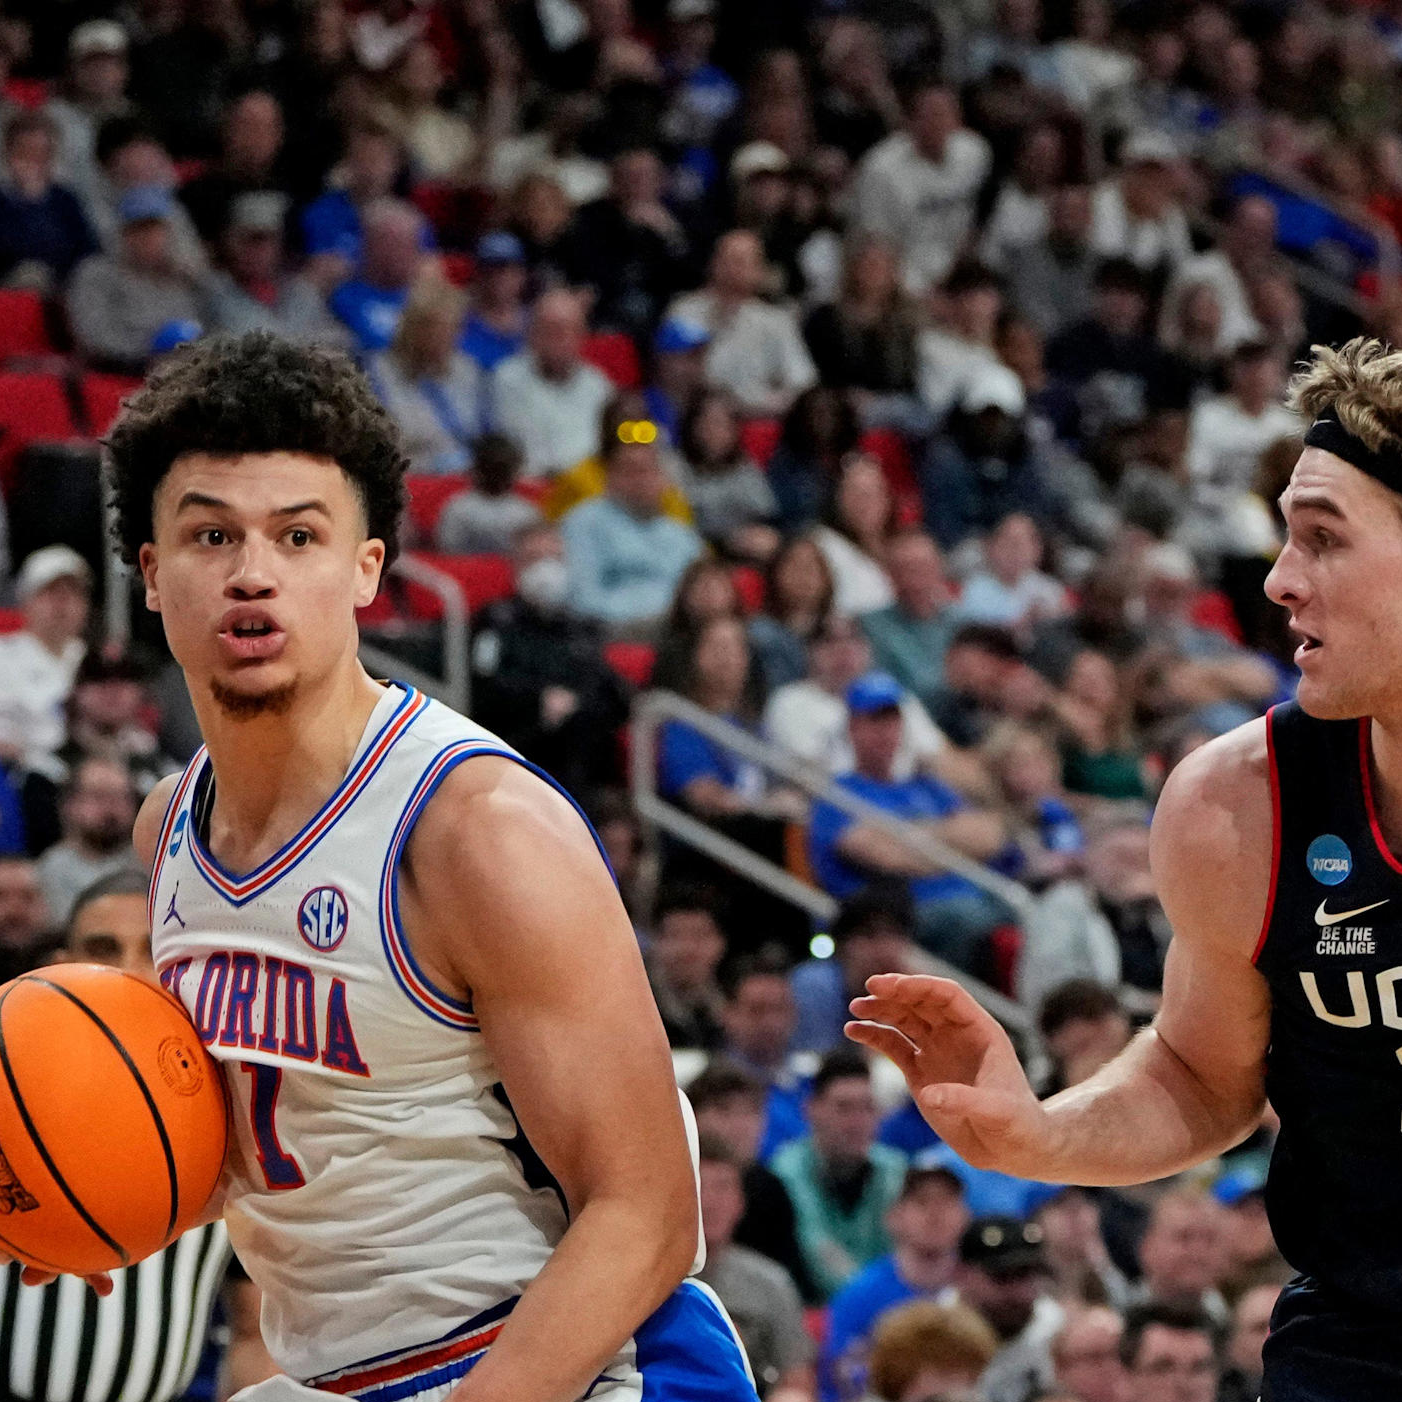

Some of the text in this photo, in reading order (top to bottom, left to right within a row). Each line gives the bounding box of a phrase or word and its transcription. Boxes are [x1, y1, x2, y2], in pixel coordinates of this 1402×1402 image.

[1312, 857, 1350, 872] NCAA
[302, 886, 348, 950] SEC
[1321, 926, 1373, 941] BE THE
[1316, 941, 1376, 955] CHANGE
[160, 950, 371, 1078] ORIDA
[240, 1062, 306, 1190] 1
